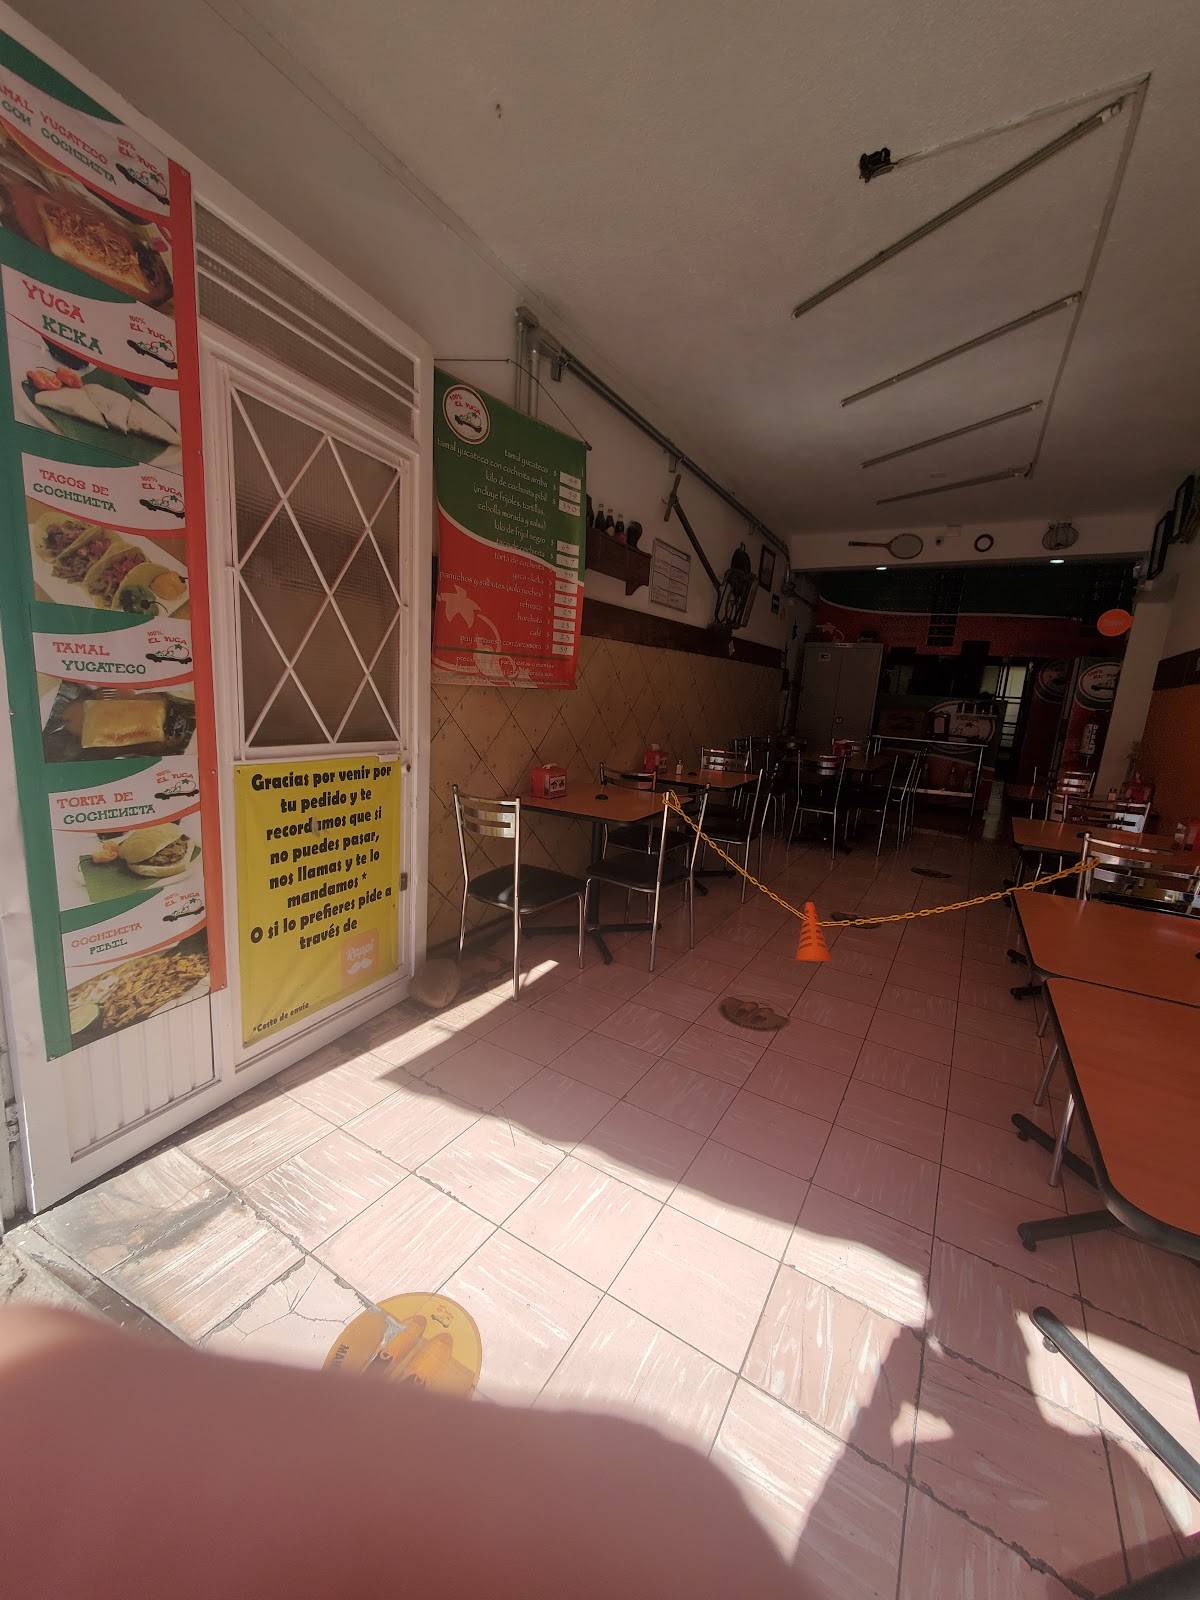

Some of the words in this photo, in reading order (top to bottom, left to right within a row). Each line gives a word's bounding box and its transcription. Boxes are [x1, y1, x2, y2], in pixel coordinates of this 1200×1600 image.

[1, 100, 32, 127] CON
[41, 127, 117, 185] COCHINITA
[40, 110, 108, 165] YUCATECO
[22, 279, 85, 324] YUCA
[41, 314, 103, 355] KEKA
[129, 322, 144, 333] EL
[39, 468, 86, 490] TACOS
[91, 483, 109, 497] DE
[141, 483, 155, 491] EL
[33, 483, 117, 513] COCHINITA
[52, 641, 110, 656] TAMAL
[163, 635, 188, 645] YUCA
[62, 659, 147, 675] YUCATECO
[251, 772, 309, 791] Gracias
[313, 772, 335, 788] por
[339, 765, 370, 781] venir
[373, 765, 392, 780] por
[56, 794, 107, 809] TORTA
[113, 791, 134, 803] DE
[280, 798, 297, 813] tu
[301, 790, 347, 813] pedido
[350, 792, 358, 806] y
[360, 788, 372, 801] te
[63, 804, 156, 825] COCHINITA
[349, 811, 371, 826] que
[374, 806, 382, 821] si
[270, 849, 288, 865] no
[292, 838, 340, 863] puedes
[342, 831, 380, 849] pasar,
[269, 874, 293, 889] nos
[297, 860, 342, 882] llamas
[345, 858, 353, 872] y
[356, 853, 367, 865] te
[370, 849, 380, 861] lo
[250, 926, 264, 943] O
[267, 920, 279, 939] si
[283, 917, 296, 933] lo
[300, 899, 355, 930] prefieres
[358, 890, 383, 910] pide
[385, 886, 392, 898] a
[71, 922, 144, 948] COCHINITA
[89, 937, 128, 955] PIBIL
[299, 923, 340, 949] través
[343, 917, 358, 933] de
[279, 1010, 289, 1022] de
